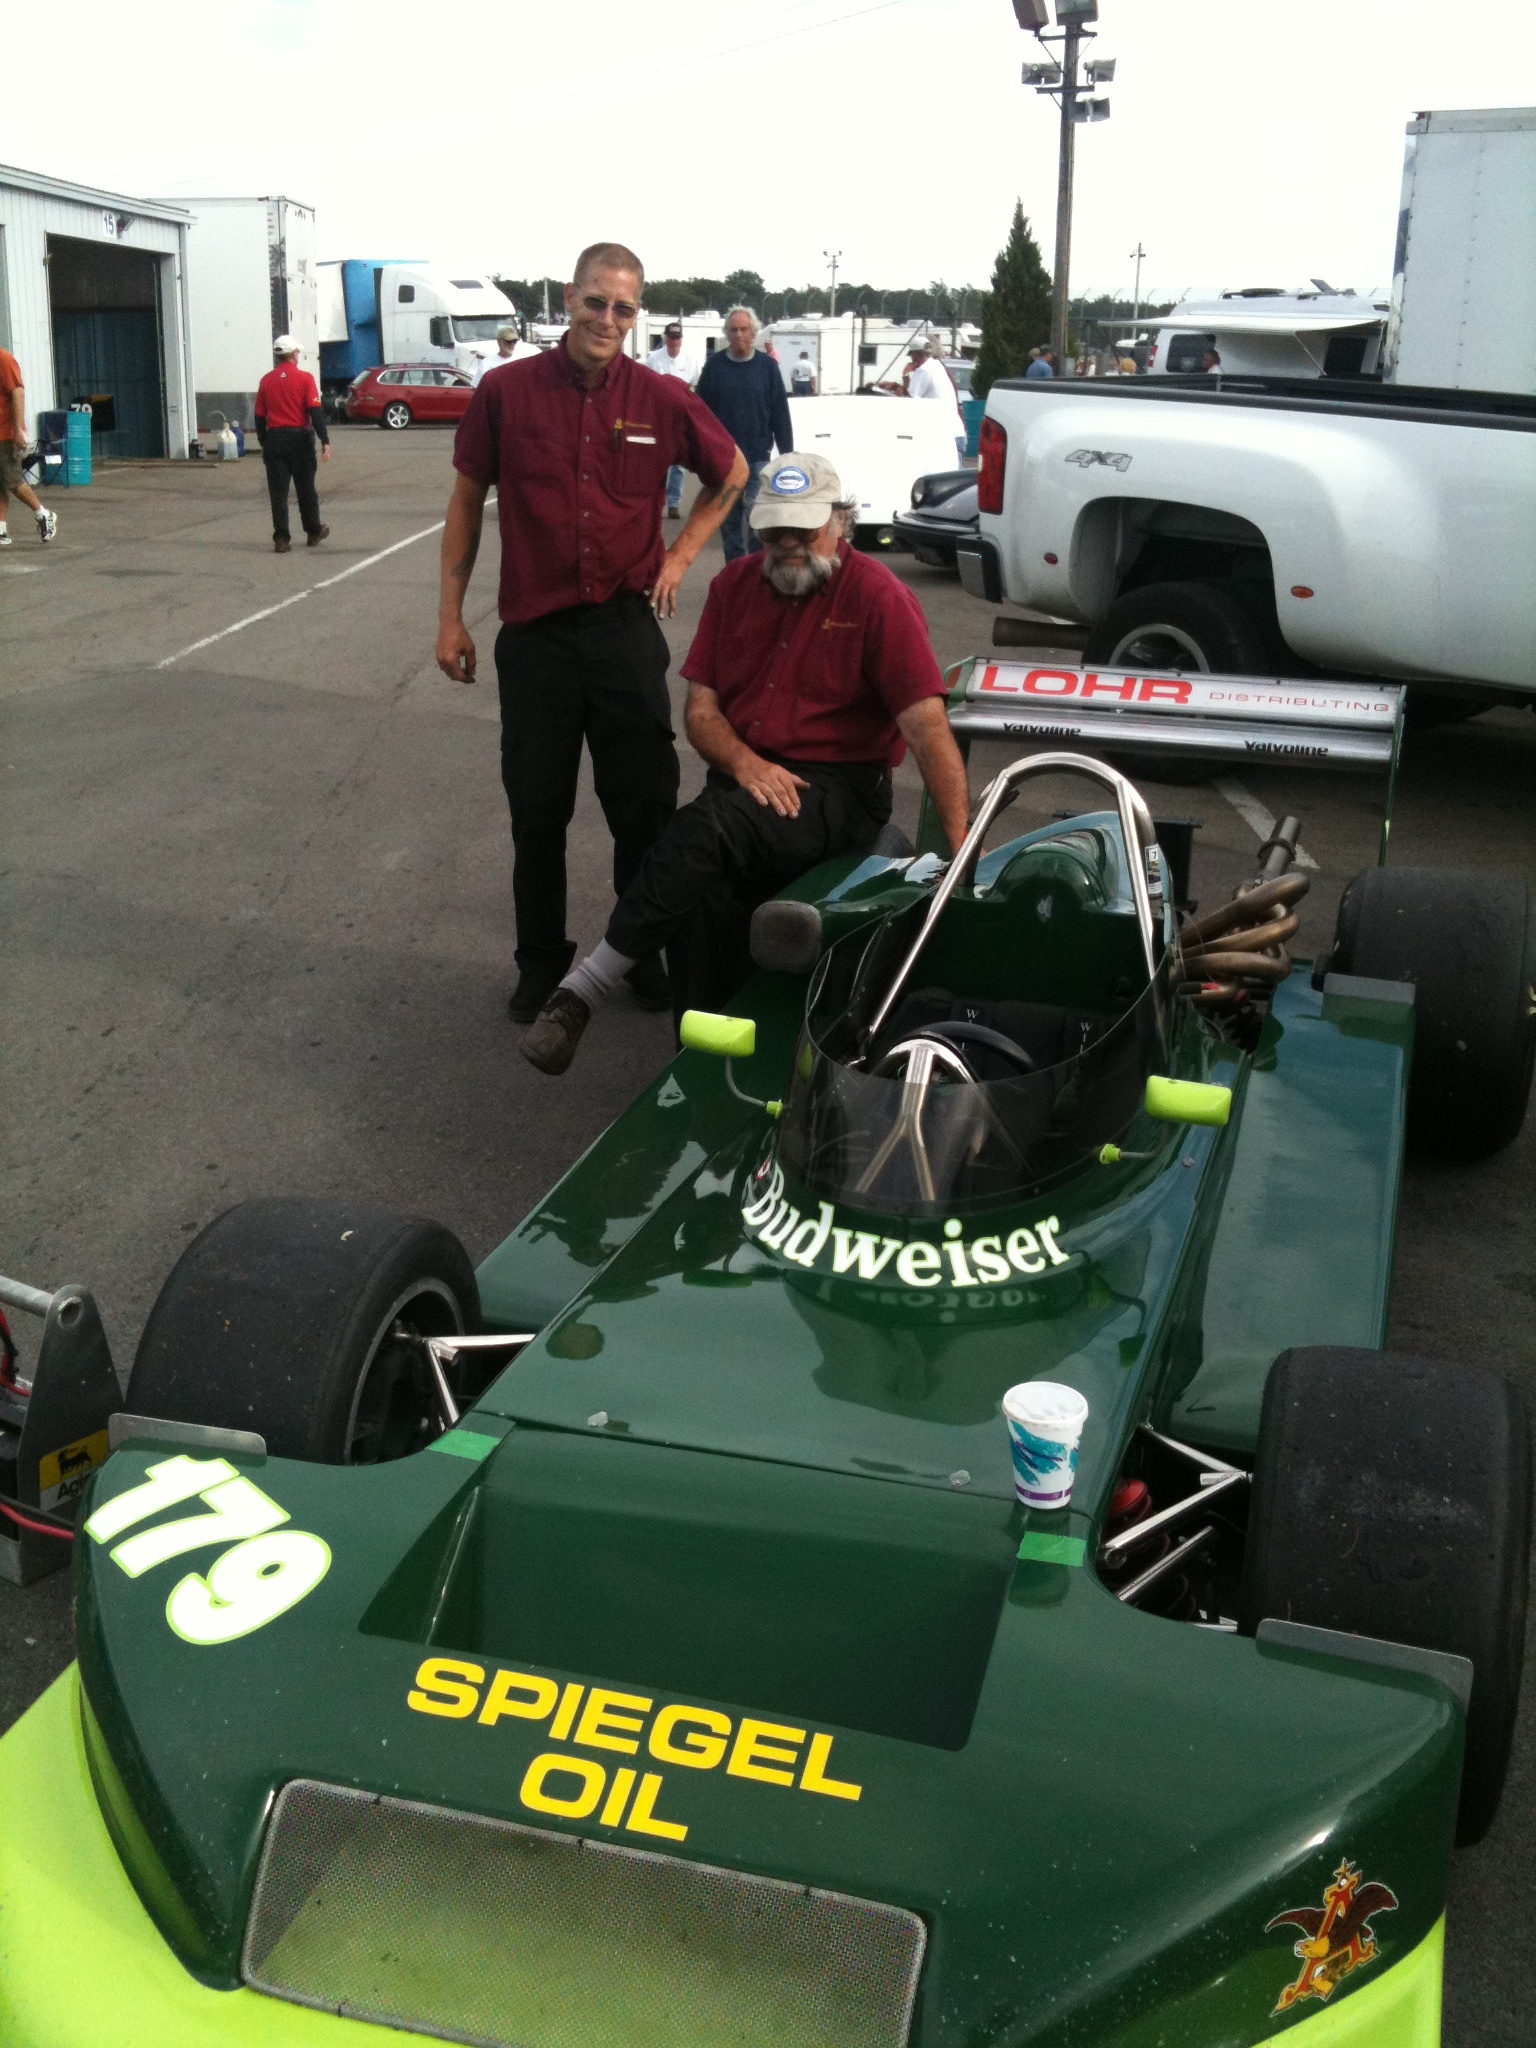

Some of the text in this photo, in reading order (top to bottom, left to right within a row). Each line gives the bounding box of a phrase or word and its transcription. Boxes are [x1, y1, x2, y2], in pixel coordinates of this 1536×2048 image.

[103, 213, 115, 236] 15
[979, 665, 1390, 712] LOHR DISTRIBUTING
[1003, 722, 1082, 737] Valvoline
[1244, 740, 1329, 757] Valvoline
[741, 1160, 1071, 1287] Budweiser
[84, 1455, 332, 1645] 179
[407, 1657, 862, 1801] SPIEGEL
[519, 1753, 689, 1842] OIL
